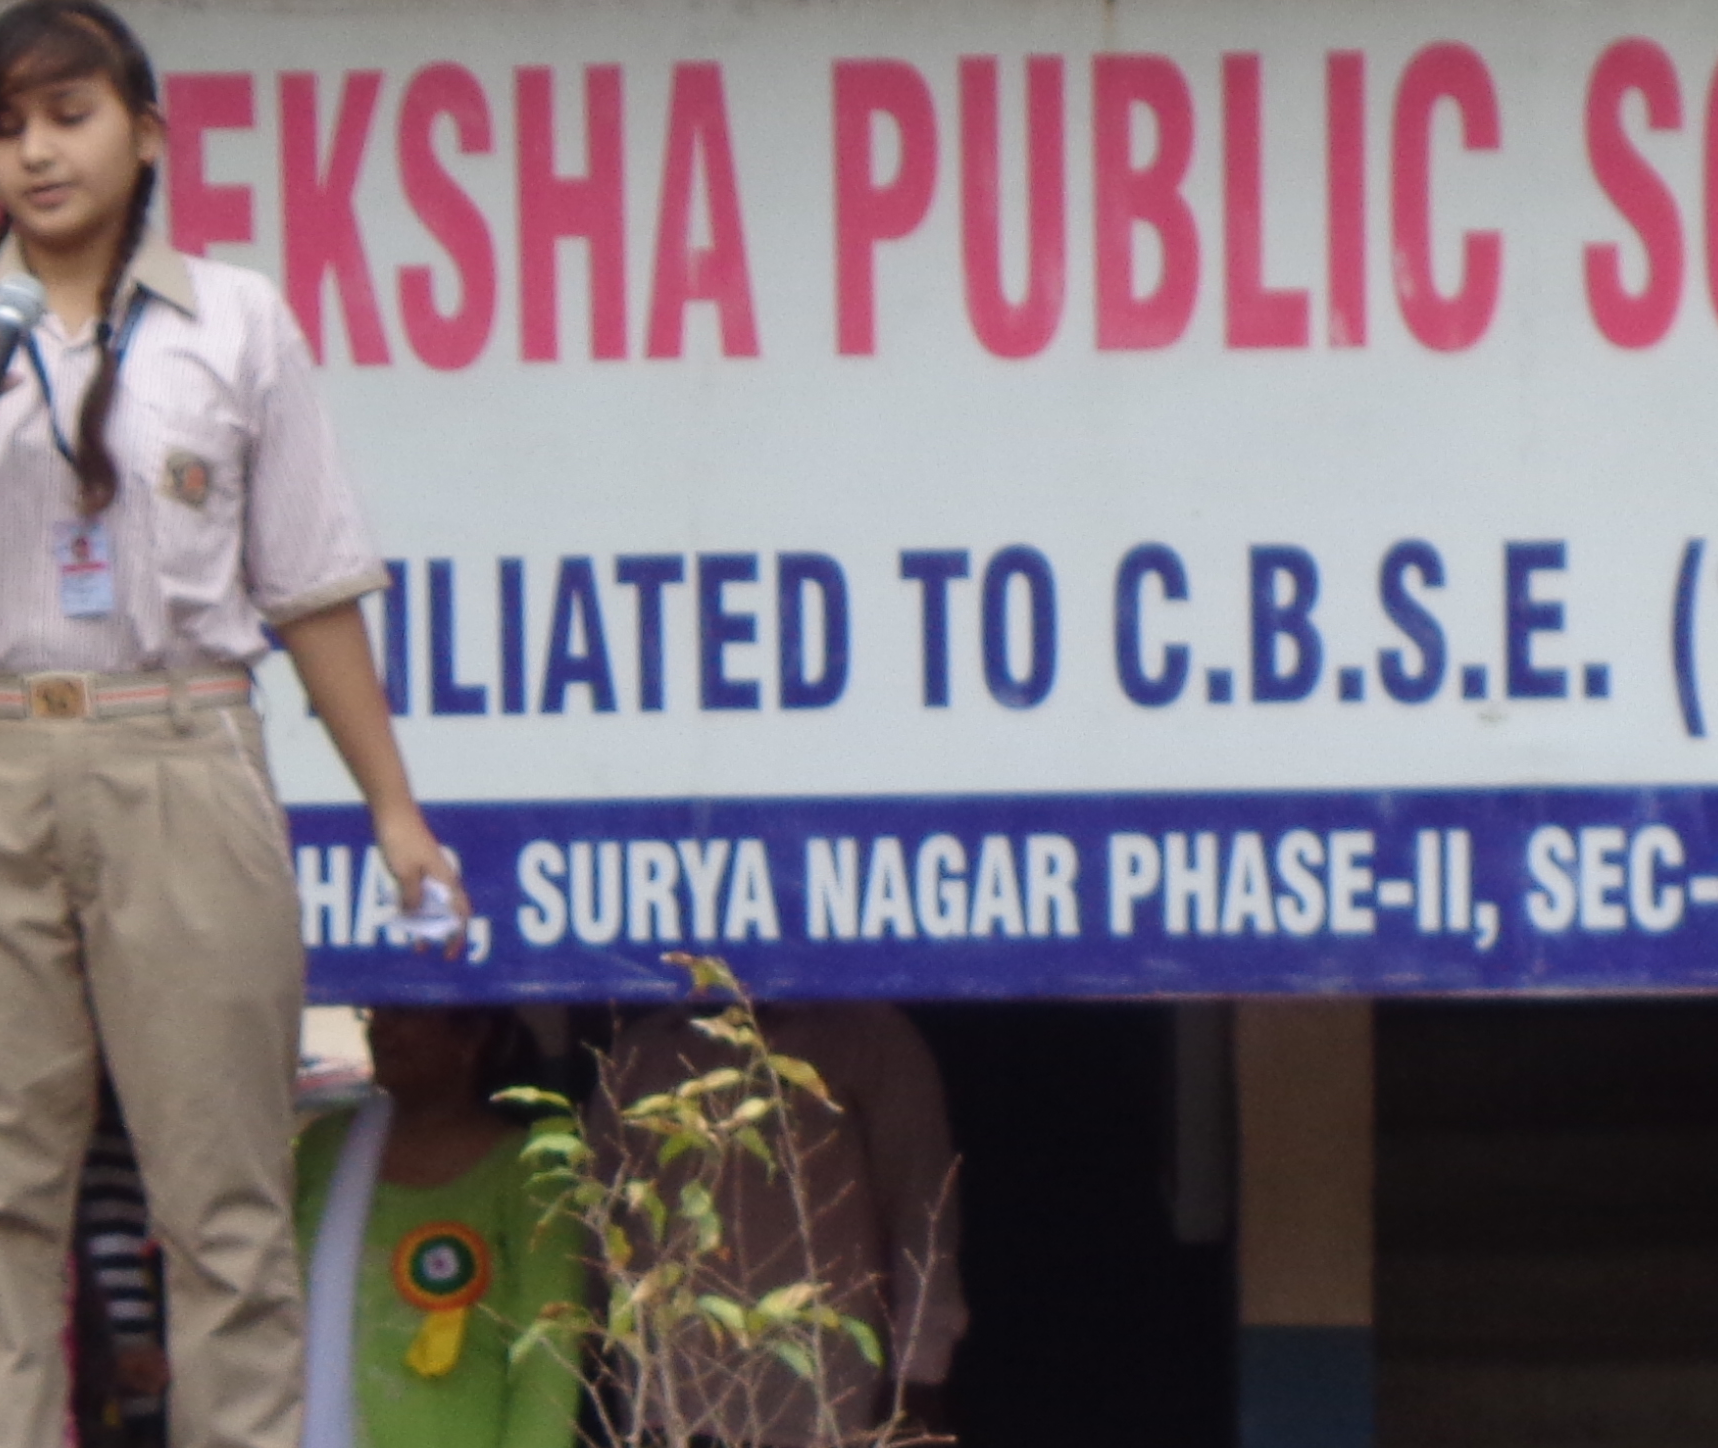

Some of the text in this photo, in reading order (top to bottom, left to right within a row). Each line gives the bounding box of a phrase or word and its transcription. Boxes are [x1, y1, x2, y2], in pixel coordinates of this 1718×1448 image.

[831, 42, 1502, 358] PUBLIC
[263, 550, 851, 718] ILIATED
[899, 544, 1061, 712] TO
[1113, 537, 1612, 708] C.B.S.E.
[515, 838, 783, 946] SURYA
[804, 833, 1081, 944] NAGAR
[1107, 829, 1502, 950] PHASE-II,
